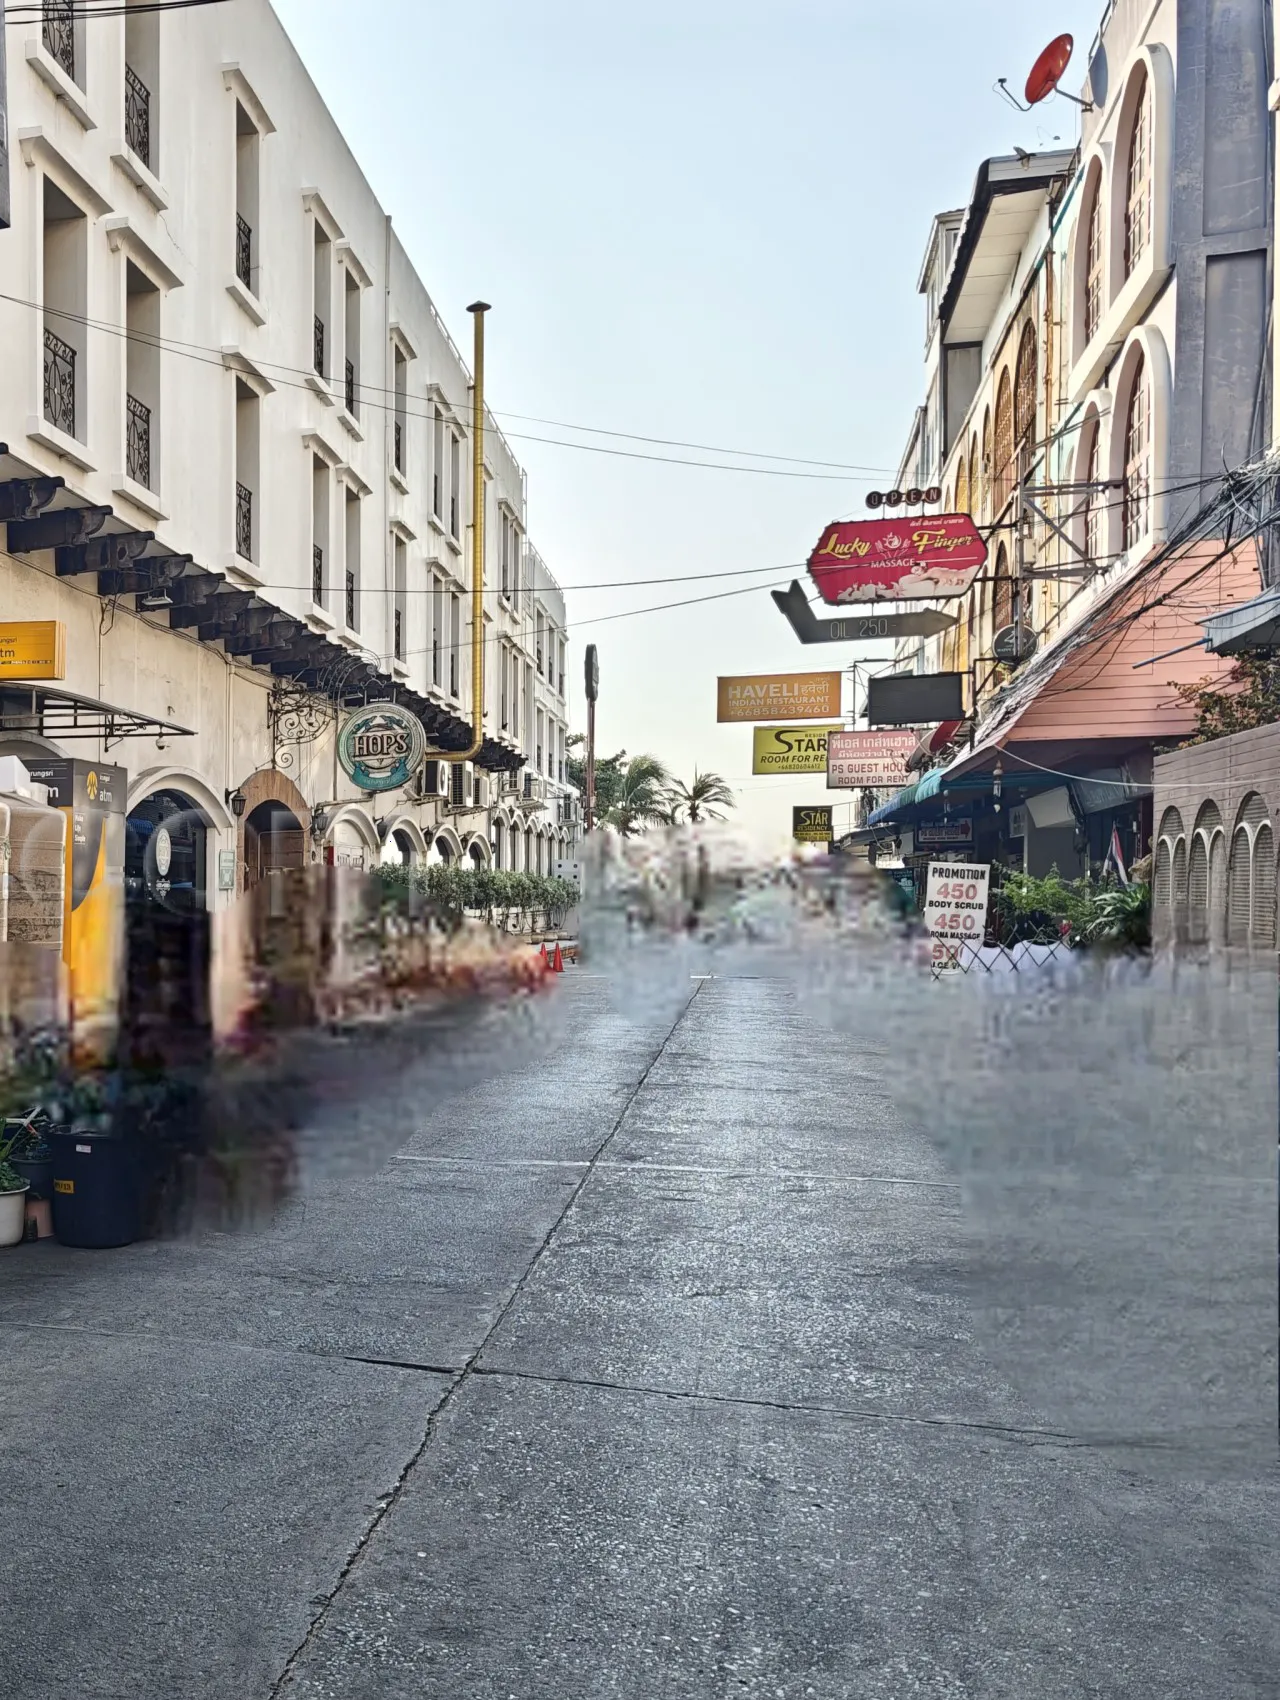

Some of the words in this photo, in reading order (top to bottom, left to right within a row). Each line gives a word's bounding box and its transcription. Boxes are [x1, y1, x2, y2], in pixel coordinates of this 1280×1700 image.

[871, 489, 938, 504] OPEN
[819, 533, 872, 560] Lucky
[912, 529, 972, 554] Finger
[870, 558, 916, 569] MASSAGE
[830, 621, 851, 639] OIL
[728, 683, 799, 699] HAVELI
[728, 699, 764, 707] INDIAN
[766, 696, 830, 705] RESTAURANT
[353, 732, 409, 756] HOPS
[760, 755, 790, 763] ROOM
[791, 754, 811, 762] FOR
[812, 754, 828, 762] RE
[30, 770, 54, 778] rungsri
[831, 764, 844, 774] PS
[847, 763, 880, 774] GUEST
[838, 776, 864, 785] ROOM
[866, 775, 884, 784] FOR
[886, 774, 909, 783] RENT
[99, 788, 113, 802] atm
[797, 810, 829, 826] STAR
[932, 867, 986, 880] PROMOTION
[936, 882, 978, 900] 450
[928, 900, 952, 908] BODY
[954, 901, 984, 910] SCRUB
[934, 913, 976, 931] 450
[932, 943, 965, 960] 50
